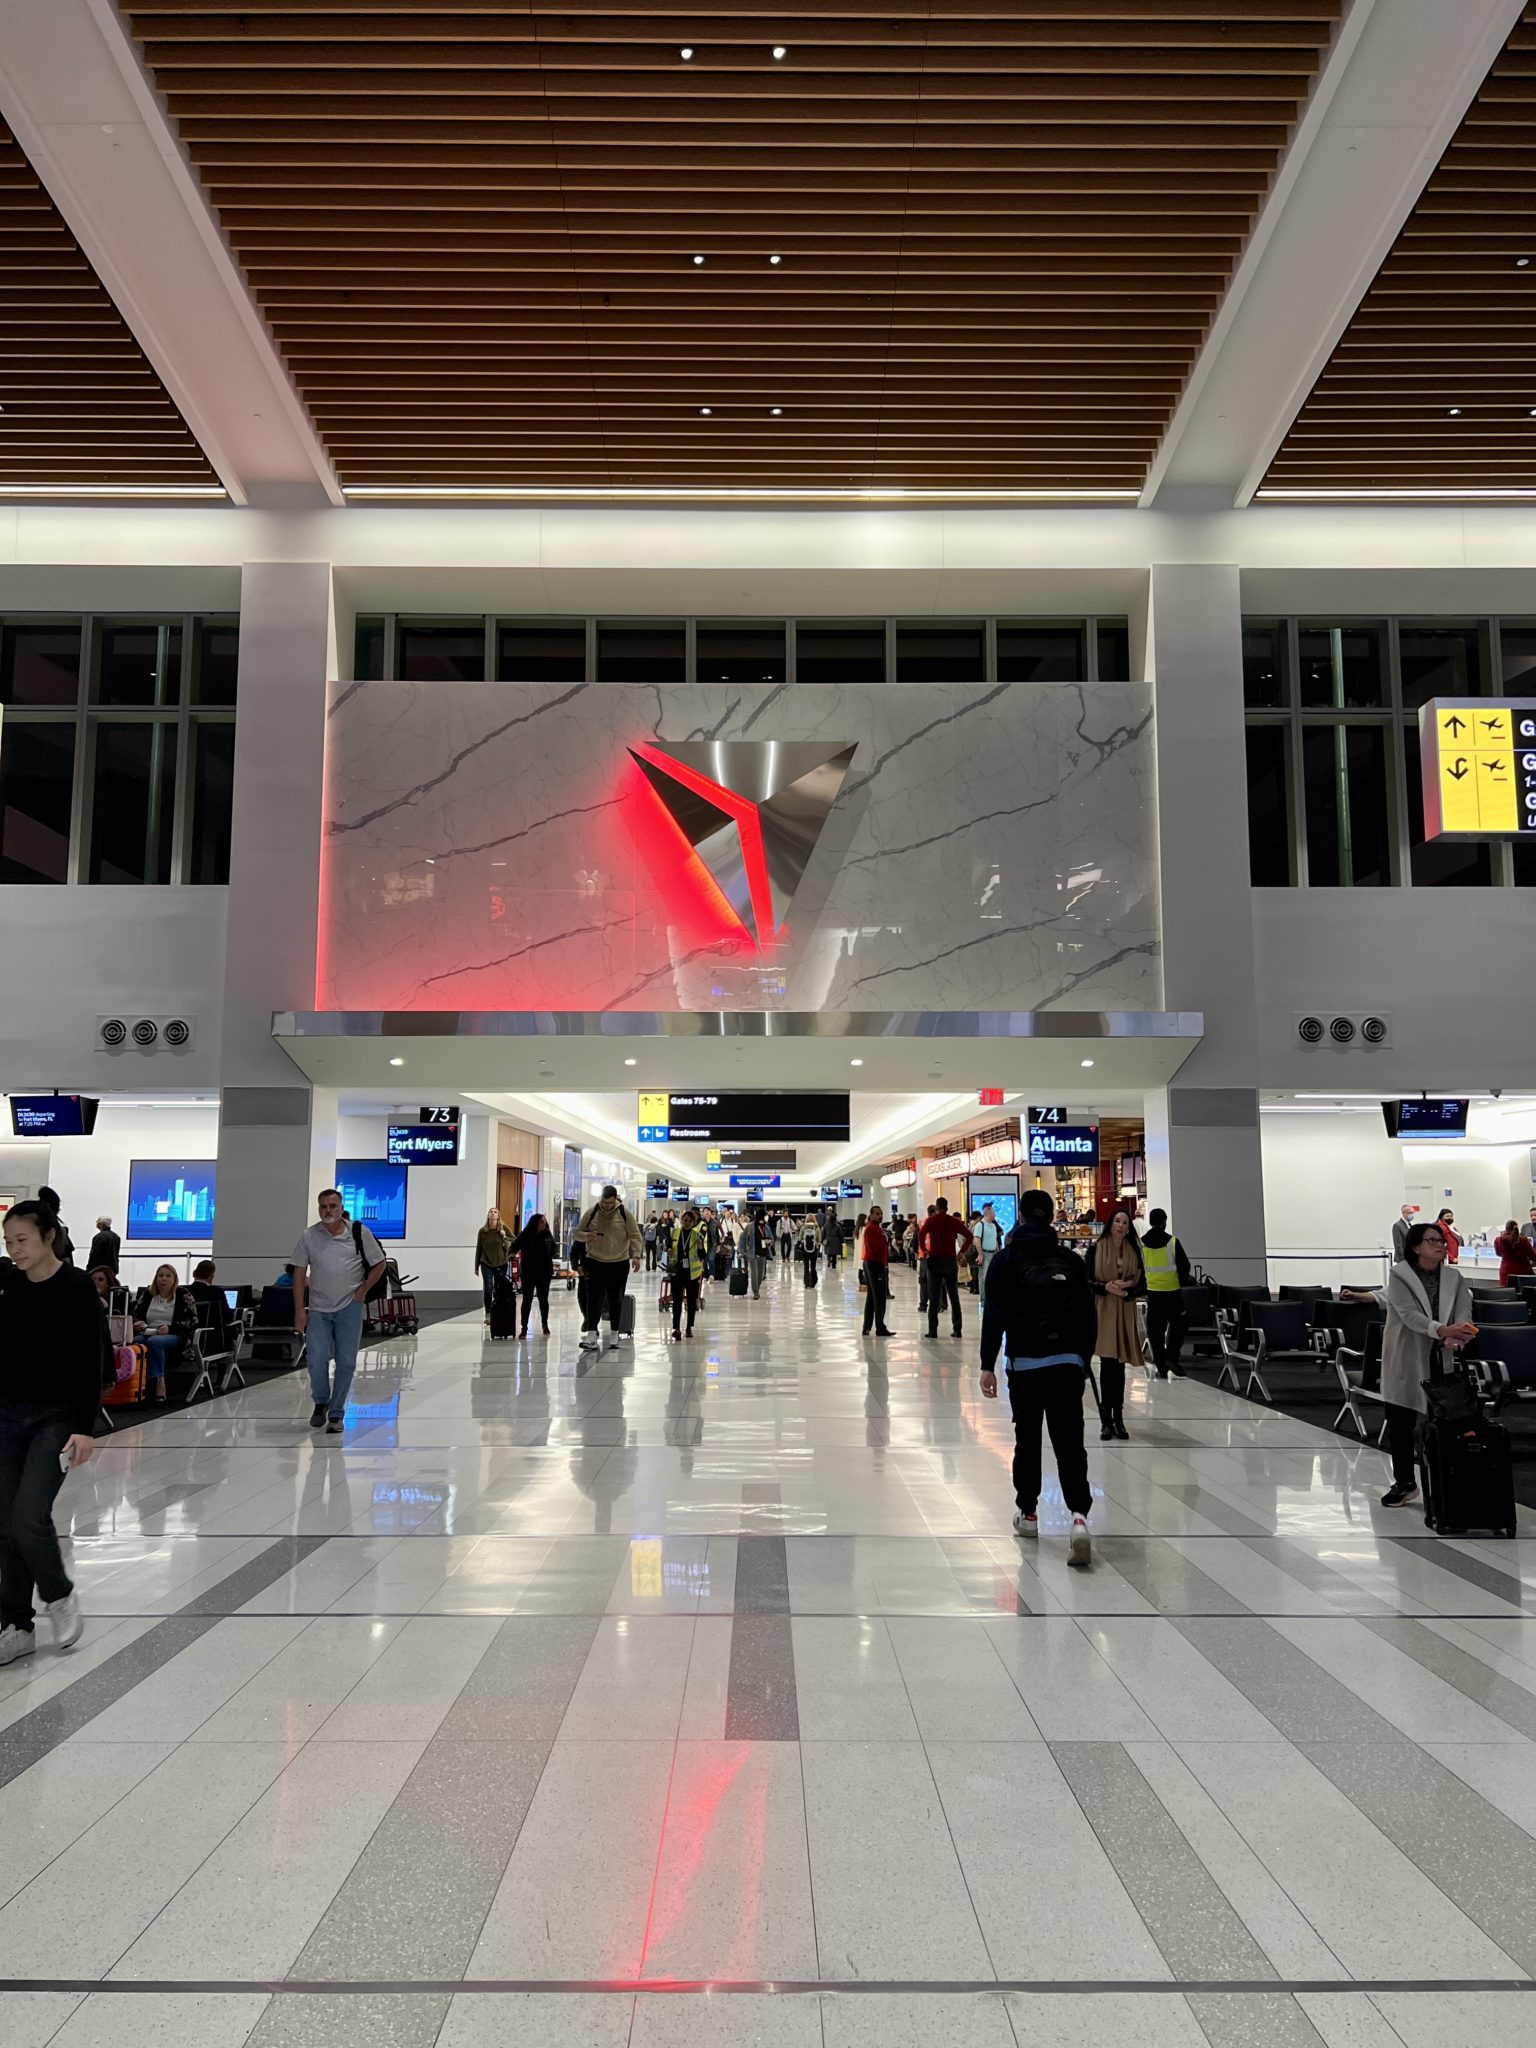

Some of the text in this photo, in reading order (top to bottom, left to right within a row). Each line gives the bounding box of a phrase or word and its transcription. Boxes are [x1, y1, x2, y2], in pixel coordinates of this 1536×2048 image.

[670, 1097, 718, 1105] Gates 75-79
[428, 1107, 450, 1122] 73
[1036, 1108, 1059, 1123] 74
[669, 1129, 711, 1137] Restrooms
[389, 1137, 454, 1152] Fort Myers
[1030, 1136, 1093, 1152] Atlanta
